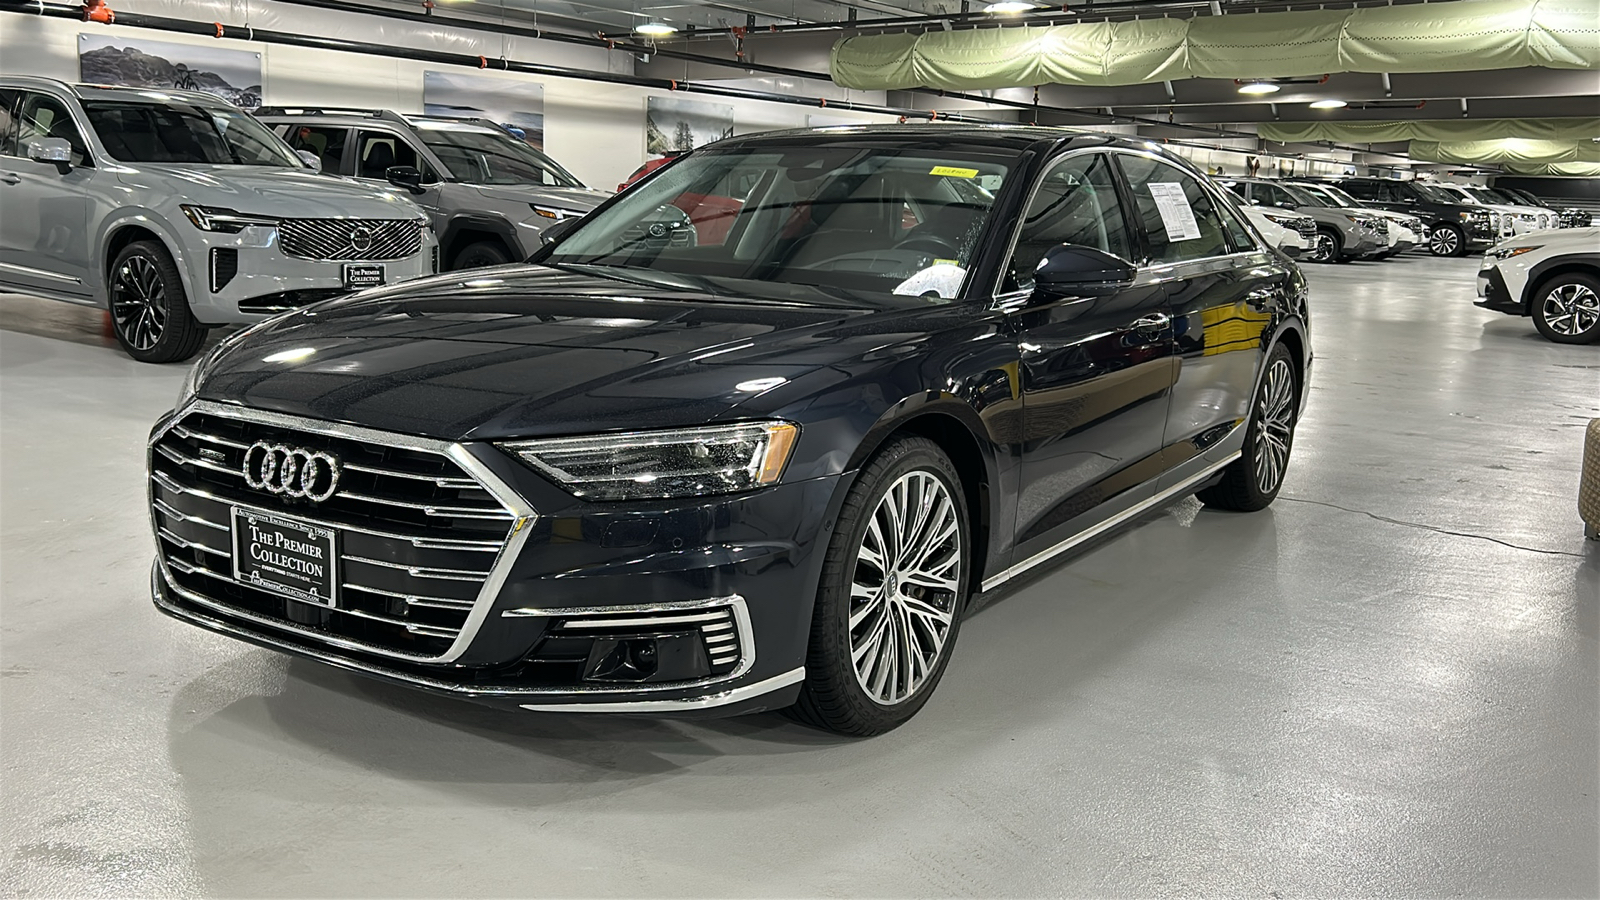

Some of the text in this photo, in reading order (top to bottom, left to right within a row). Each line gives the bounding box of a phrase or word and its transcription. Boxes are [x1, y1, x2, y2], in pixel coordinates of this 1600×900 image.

[238, 509, 328, 538] AUTOMOTIVE EXCELLENCE SINCE 1995
[248, 525, 323, 559] THE PREMIER
[250, 542, 323, 577] COLLECTION
[261, 564, 286, 576] EVERYTHING
[286, 571, 300, 580] STARTS
